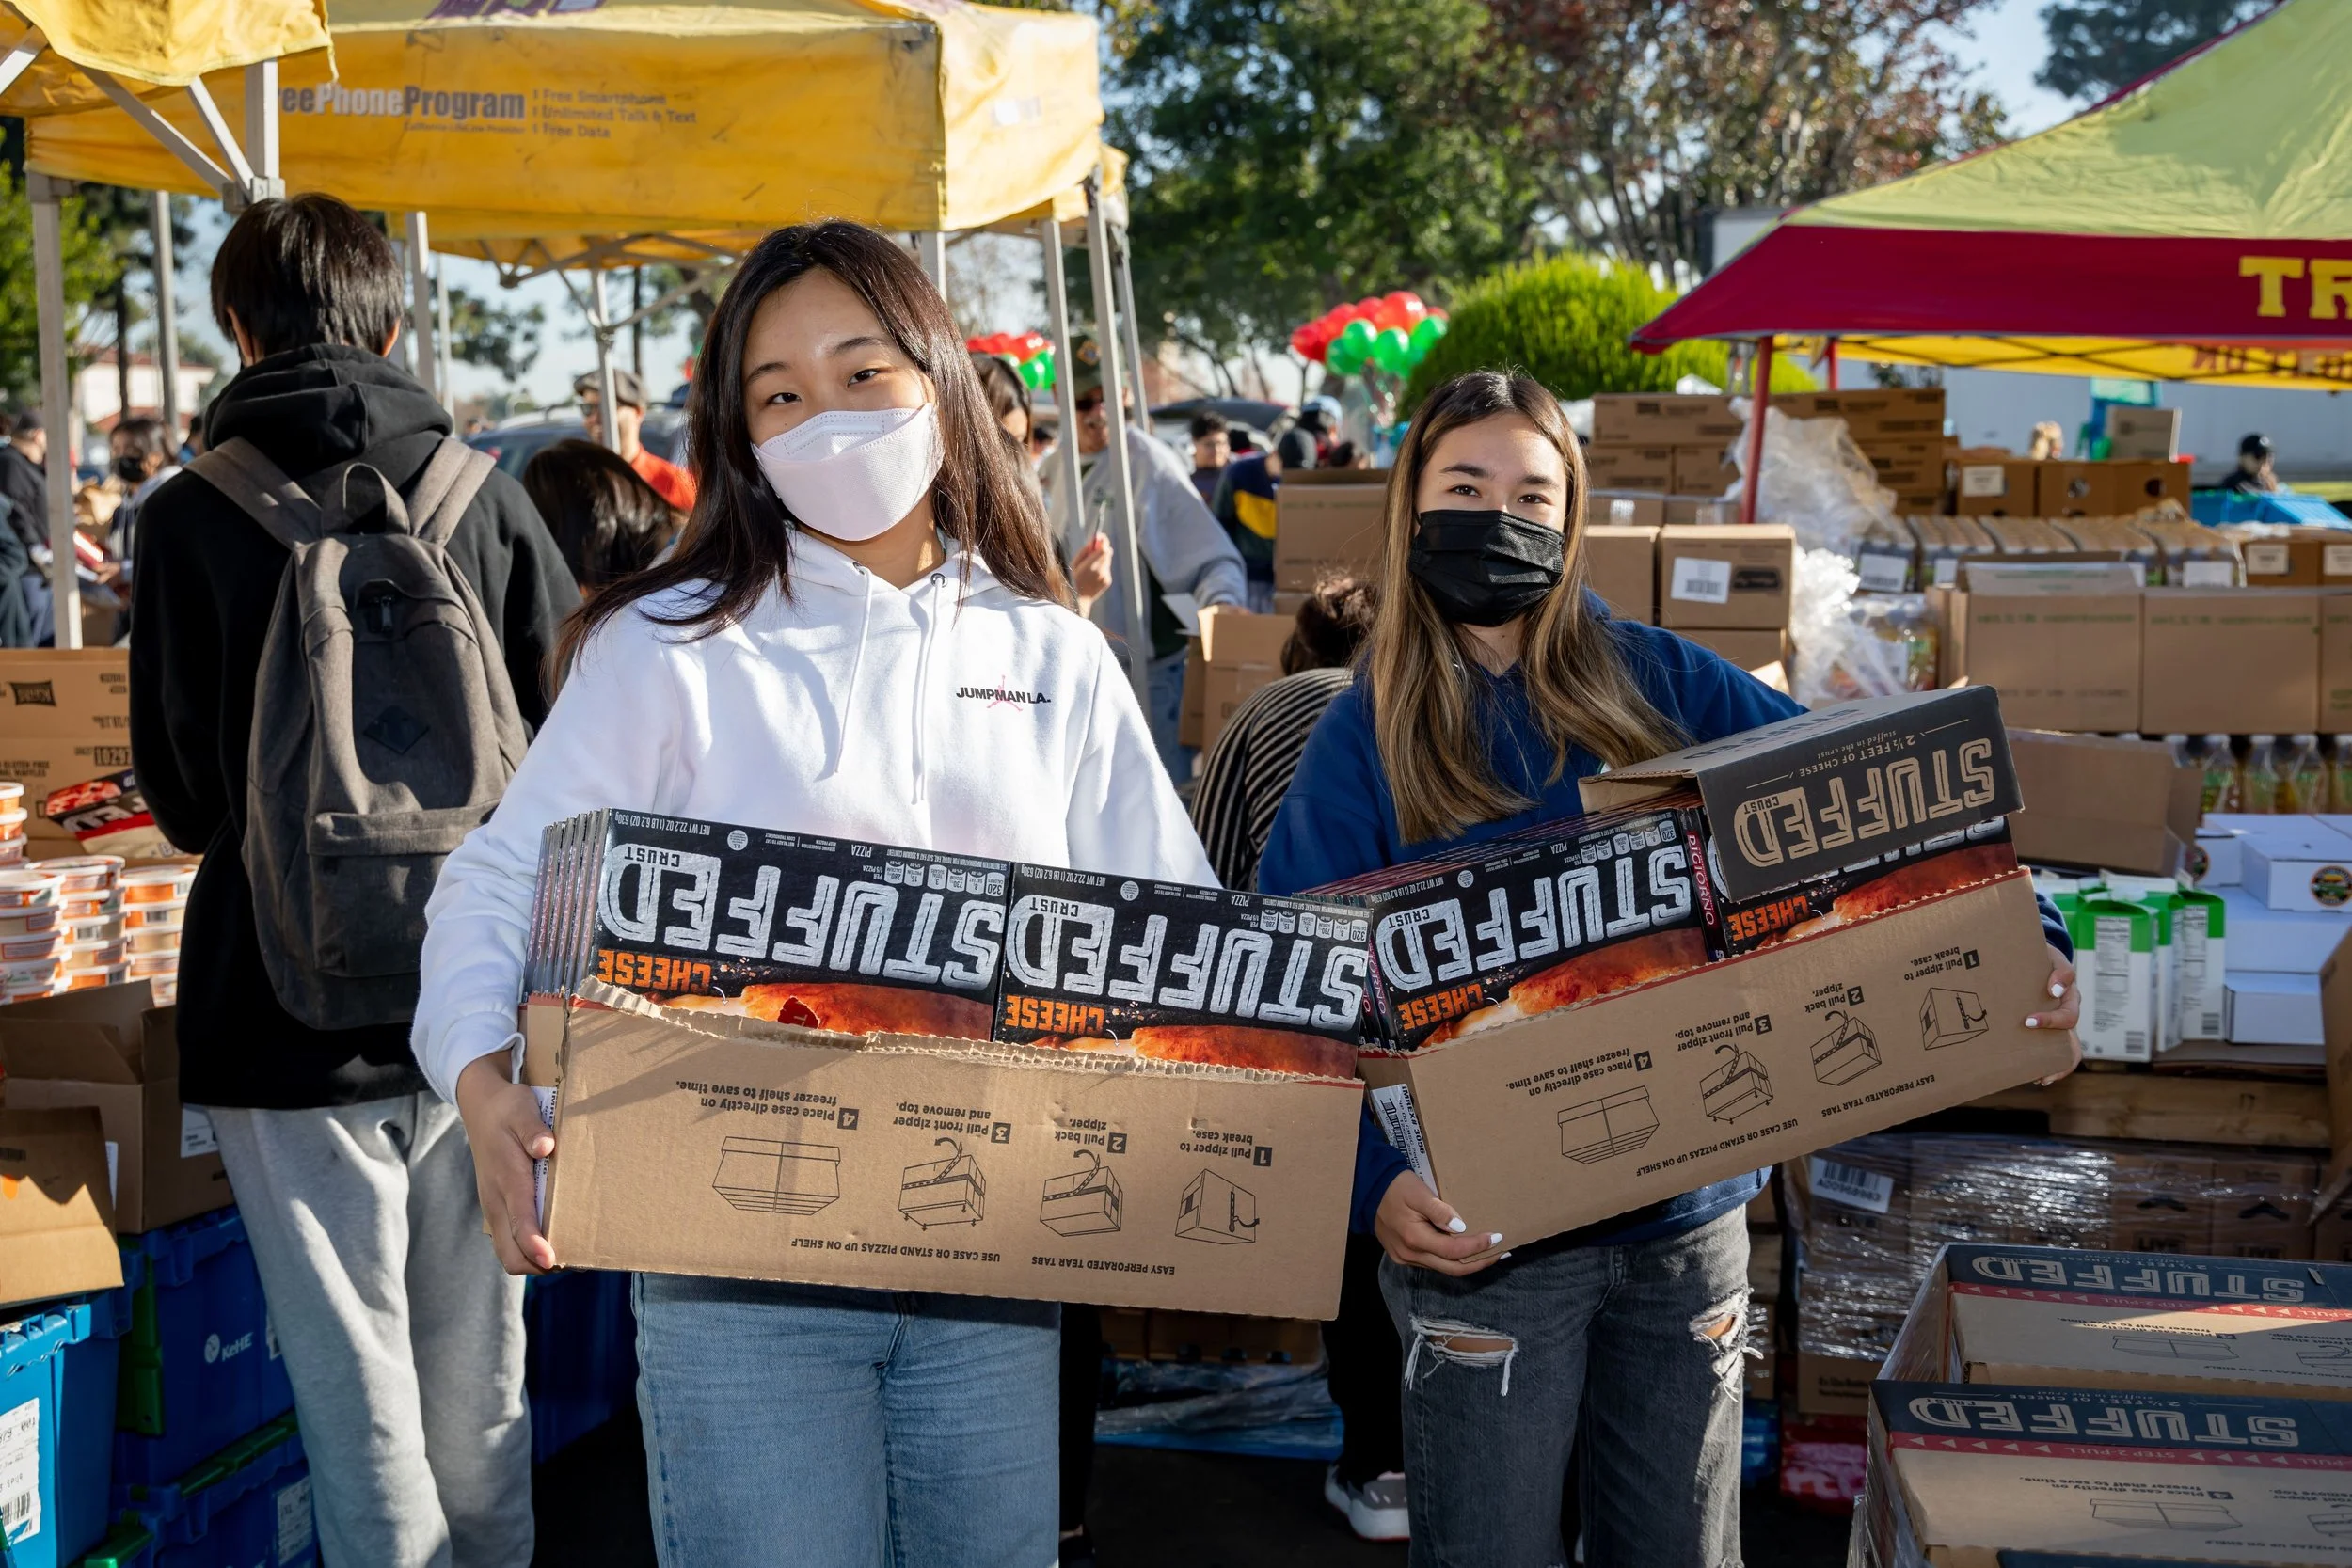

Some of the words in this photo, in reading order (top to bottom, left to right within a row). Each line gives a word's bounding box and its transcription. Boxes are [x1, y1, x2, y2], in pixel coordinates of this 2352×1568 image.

[278, 84, 525, 119] eePhoneProgram
[543, 88, 573, 102] Free
[542, 105, 613, 120] Unlimited
[618, 106, 647, 121] Talk
[666, 110, 697, 123] Text
[543, 123, 573, 136] Free
[577, 124, 611, 138] Data
[956, 687, 1026, 704] JUMPMAN
[1855, 739, 1866, 749] in
[1866, 728, 1898, 746] stuffed
[1905, 735, 1915, 746] 2
[1816, 747, 1839, 760] crust
[1840, 742, 1854, 753] the
[1857, 741, 1891, 759] FEET
[1840, 752, 1855, 764] OF
[1798, 757, 1839, 776] CHEESE
[1733, 737, 1995, 868] STUFFED
[1742, 795, 1779, 814] CRUST
[613, 811, 629, 825] 630g
[629, 814, 640, 826] OZ)
[640, 816, 650, 827] 6.2
[650, 817, 659, 829] LB
[665, 819, 673, 831] OZ
[674, 820, 688, 832] 22.2
[688, 822, 697, 833] WT
[698, 824, 709, 835] NET
[850, 844, 871, 857] PIZZA
[1549, 841, 1567, 854] PIZZA
[623, 846, 680, 867] CRUST
[1020, 863, 1033, 877] 630g
[1034, 866, 1043, 878] OZ)
[1043, 868, 1053, 879] 6.2
[1053, 870, 1059, 879] LB
[1066, 872, 1073, 881] OZ
[1073, 873, 1085, 883] 22.2
[1085, 875, 1095, 884] WT
[1095, 876, 1105, 886] NET
[1690, 834, 1716, 927] DIGIORNO
[987, 883, 1002, 895] 320
[1029, 896, 1078, 916] CRUST
[1230, 894, 1248, 906] PIZZA
[598, 843, 1005, 990] STUFFED
[1375, 846, 1692, 990] STUFFED
[1386, 907, 1430, 929] CRUST
[1727, 895, 1810, 942] CHEESE
[1933, 946, 1960, 961] break
[1007, 895, 1369, 1031] STUFFED
[1909, 954, 1933, 968] case.
[1944, 957, 1963, 970] Pull
[597, 949, 712, 991] CHEESE
[1914, 960, 1944, 979] zipper
[1902, 972, 1914, 982] to
[1810, 980, 1844, 1000] zipper.
[1827, 992, 1846, 1006] Pull
[1401, 983, 1484, 1031] CHEESE
[1804, 999, 1827, 1014] back
[1005, 995, 1104, 1034] CHEESE
[1732, 1010, 1751, 1024] and
[1694, 1016, 1732, 1034] remove
[1734, 1022, 1754, 1036] Pull
[1672, 1025, 1694, 1041] top.
[1708, 1028, 1734, 1044] front
[1675, 1034, 1708, 1053] zipper
[1594, 1047, 1631, 1067] freezer
[1555, 1065, 1568, 1077] to
[1568, 1057, 1595, 1074] shelf
[1605, 1058, 1633, 1075] Place
[1531, 1069, 1555, 1084] save
[1581, 1067, 1605, 1081] case
[1914, 1073, 1935, 1086] EASY
[675, 1080, 707, 1094] time.
[710, 1083, 739, 1095] save
[1503, 1076, 1532, 1093] time.
[1541, 1071, 1581, 1095] directly
[741, 1086, 756, 1098] to
[758, 1088, 790, 1102] shelf
[792, 1090, 837, 1106] freezer
[1527, 1085, 1542, 1098] on
[1863, 1080, 1915, 1102] PERFORATED
[700, 1097, 716, 1108] on
[719, 1097, 770, 1115] directly
[894, 1100, 919, 1115] top.
[1840, 1096, 1864, 1110] TEAR
[771, 1103, 800, 1117] case
[802, 1106, 835, 1120] Place
[921, 1104, 966, 1117] remove
[968, 1109, 991, 1121] and
[1820, 1103, 1841, 1117] TABS
[893, 1113, 931, 1130] zipper
[933, 1118, 963, 1132] front
[1068, 1117, 1107, 1132] zipper.
[1401, 1085, 1417, 1125] IMREX#
[1413, 1128, 1425, 1154] 3056
[1780, 1117, 1798, 1130] USE
[965, 1121, 989, 1135] Pull
[1758, 1122, 1781, 1137] CASE
[1054, 1130, 1081, 1143] back
[1083, 1132, 1105, 1146] Pull
[1191, 1129, 1219, 1142] case.
[1220, 1132, 1253, 1145] break
[1717, 1133, 1745, 1149] STAND
[1745, 1130, 1758, 1141] OR
[1178, 1141, 1190, 1152] to
[1193, 1141, 1228, 1156] zipper
[1230, 1146, 1251, 1158] Pull
[1687, 1142, 1718, 1159] PIZZAS
[1661, 1156, 1676, 1168] ON
[1675, 1152, 1688, 1164] UP
[1633, 1161, 1661, 1177] SHELF
[790, 1236, 823, 1248] SHELF
[825, 1239, 841, 1250] ON
[843, 1241, 858, 1251] UP
[860, 1242, 898, 1254] PIZZAS
[899, 1244, 933, 1257] STAND
[935, 1247, 950, 1258] OR
[952, 1249, 978, 1260] CASE
[980, 1251, 1000, 1262] USE
[1030, 1255, 1056, 1266] TABS
[1058, 1257, 1084, 1268] TEAR
[1086, 1259, 1148, 1273] PERFORATED
[1151, 1263, 1175, 1275] EASY
[1972, 1256, 2305, 1303] STUFFED
[1924, 1396, 1976, 1406] CRUST
[2009, 1391, 2066, 1402] CHEESE
[2072, 1395, 2090, 1403] OF
[2094, 1396, 2144, 1406] FEET
[1908, 1397, 2300, 1448] STUFFED
[2063, 1444, 2125, 1457] 2-PULL
[2130, 1448, 2174, 1460] STEP
